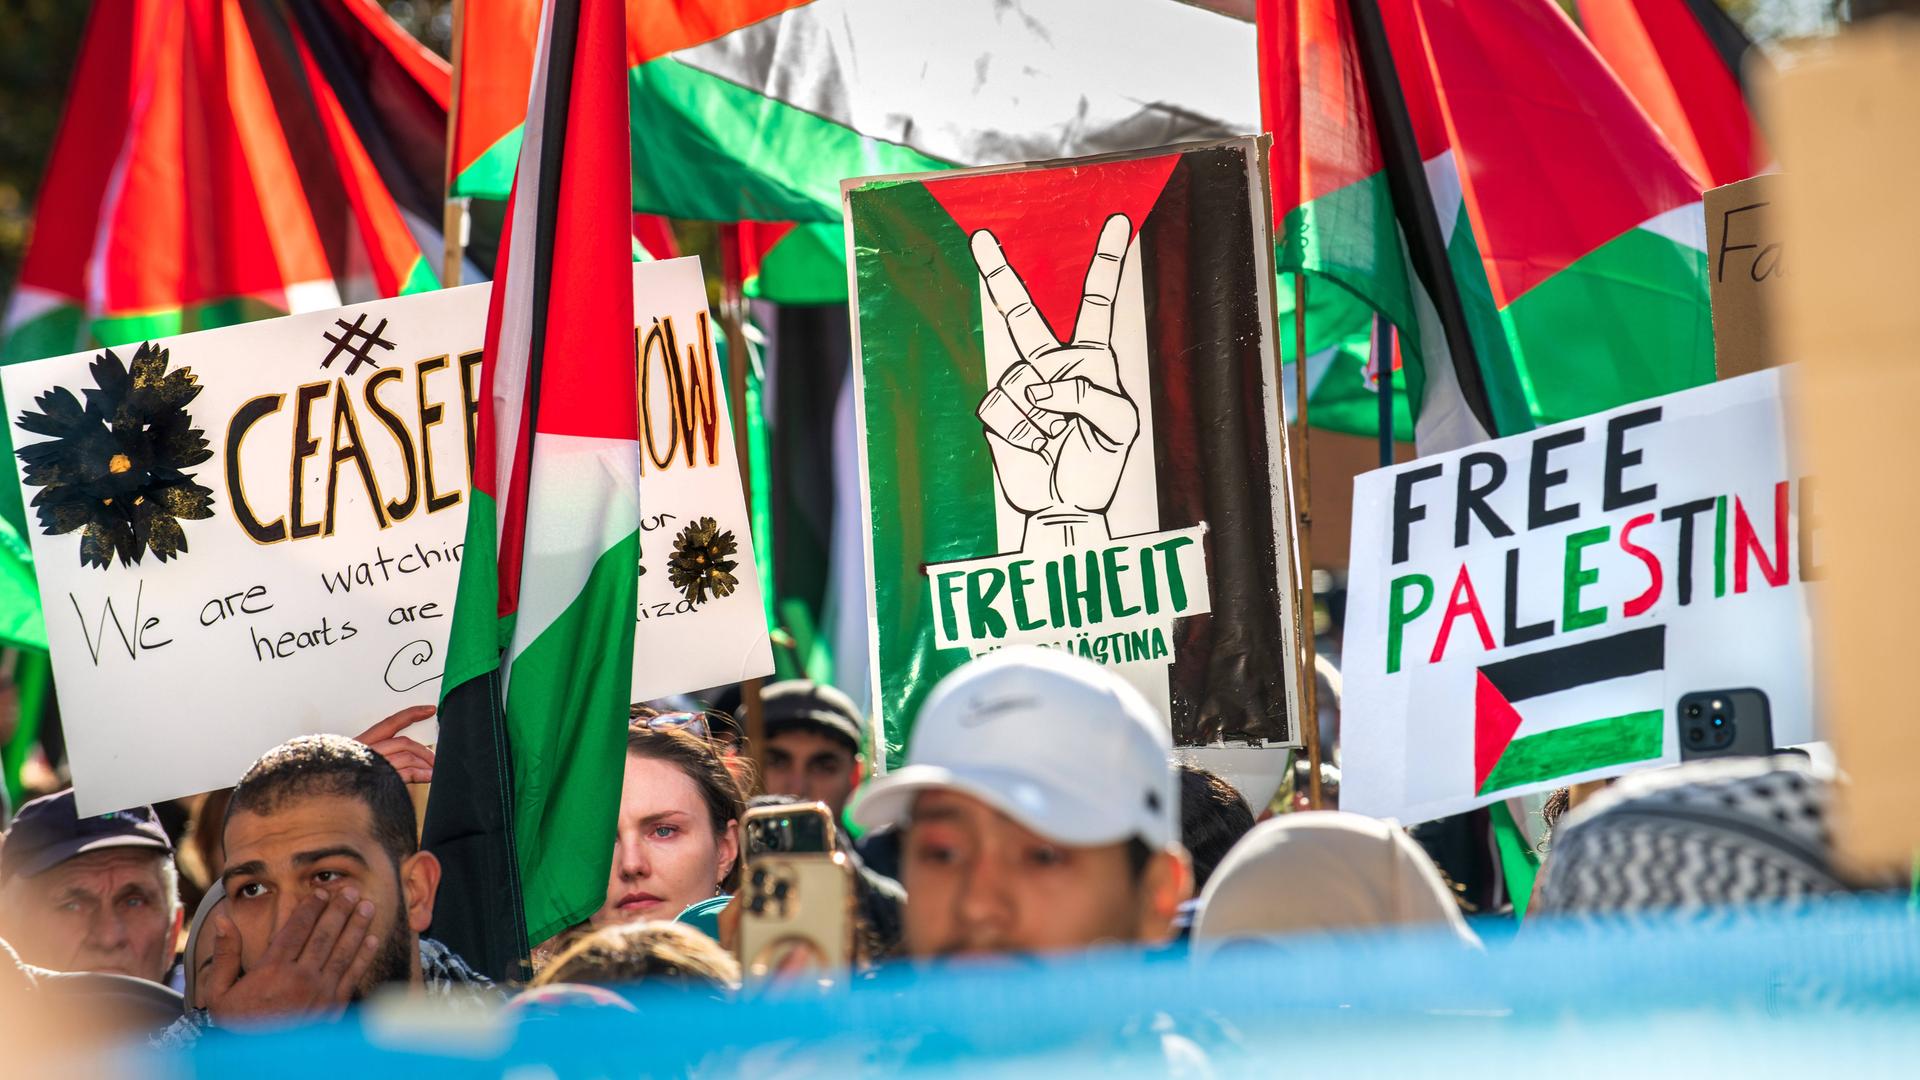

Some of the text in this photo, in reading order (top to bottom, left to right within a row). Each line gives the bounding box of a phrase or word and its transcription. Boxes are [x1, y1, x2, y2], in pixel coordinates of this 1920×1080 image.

[634, 310, 719, 478] OW
[1391, 406, 1663, 565] FREE
[69, 578, 173, 666] We
[199, 584, 275, 627] are
[321, 541, 465, 595] watchin
[250, 600, 443, 662] hearts are
[936, 536, 1195, 642] FREIHEIT
